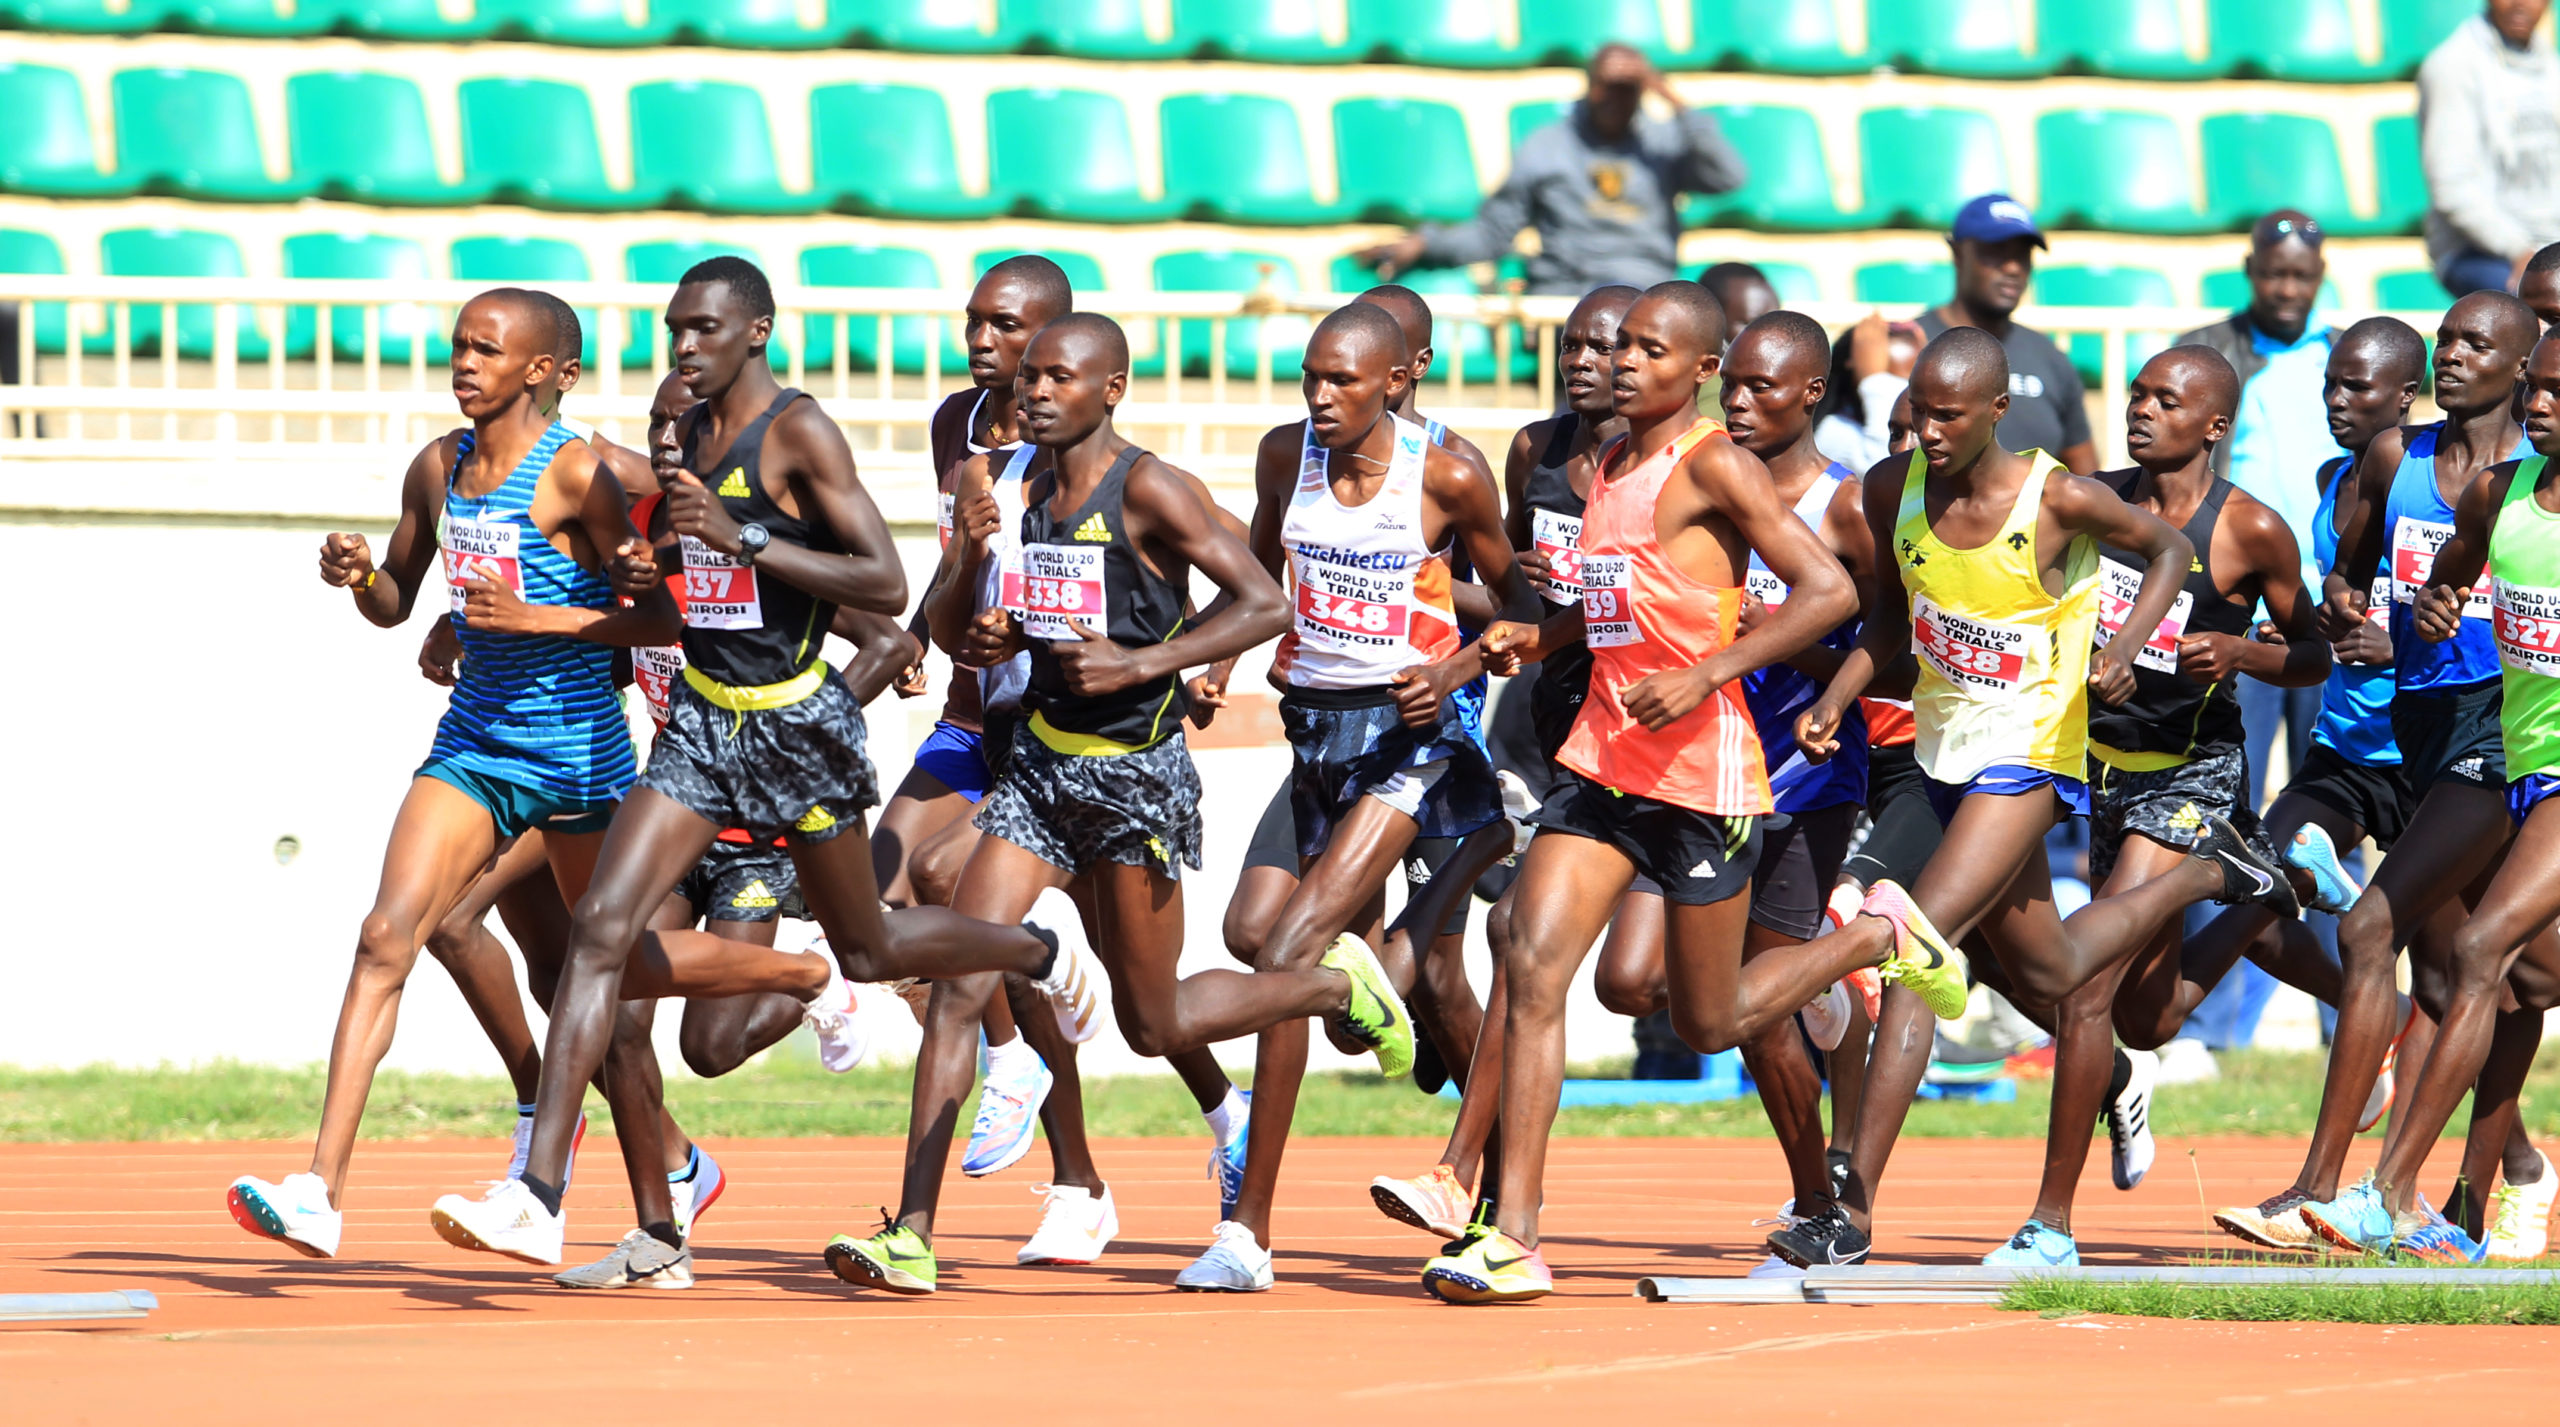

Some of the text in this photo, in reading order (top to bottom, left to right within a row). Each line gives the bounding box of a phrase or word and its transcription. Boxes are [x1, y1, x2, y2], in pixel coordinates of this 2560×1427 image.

[1073, 530, 1113, 542] adidas
[453, 538, 497, 555] TRIALS
[1297, 541, 1407, 570] Nishitetsu
[687, 553, 732, 567] TRIALS
[1033, 550, 1094, 565] WORLD U-20
[1605, 562, 1625, 573] U-20
[1037, 564, 1081, 578] TRIALS
[1319, 567, 1369, 588] WORLD
[1373, 579, 1404, 591] U-20
[2111, 569, 2139, 589] WOR
[1326, 581, 1388, 603] TRIALS
[1750, 576, 1777, 590] U-20
[1028, 579, 1084, 611] 338
[1586, 590, 1617, 618] 39
[2504, 587, 2544, 605] WORLD
[687, 603, 747, 615] AIROBI
[1308, 591, 1389, 632] 348
[1304, 618, 1394, 646] NAIROBI
[1937, 611, 2022, 643] WORLD U-20
[2503, 612, 2560, 648] 327
[1943, 625, 2005, 652] TRIALS
[644, 648, 682, 666] WORLD
[1929, 629, 2002, 674] 328
[2501, 641, 2560, 664] NAIROB
[1923, 645, 2007, 690] NAIROBI
[2451, 764, 2484, 781] adidas
[795, 815, 837, 832] adidas
[731, 897, 778, 908] adidas
